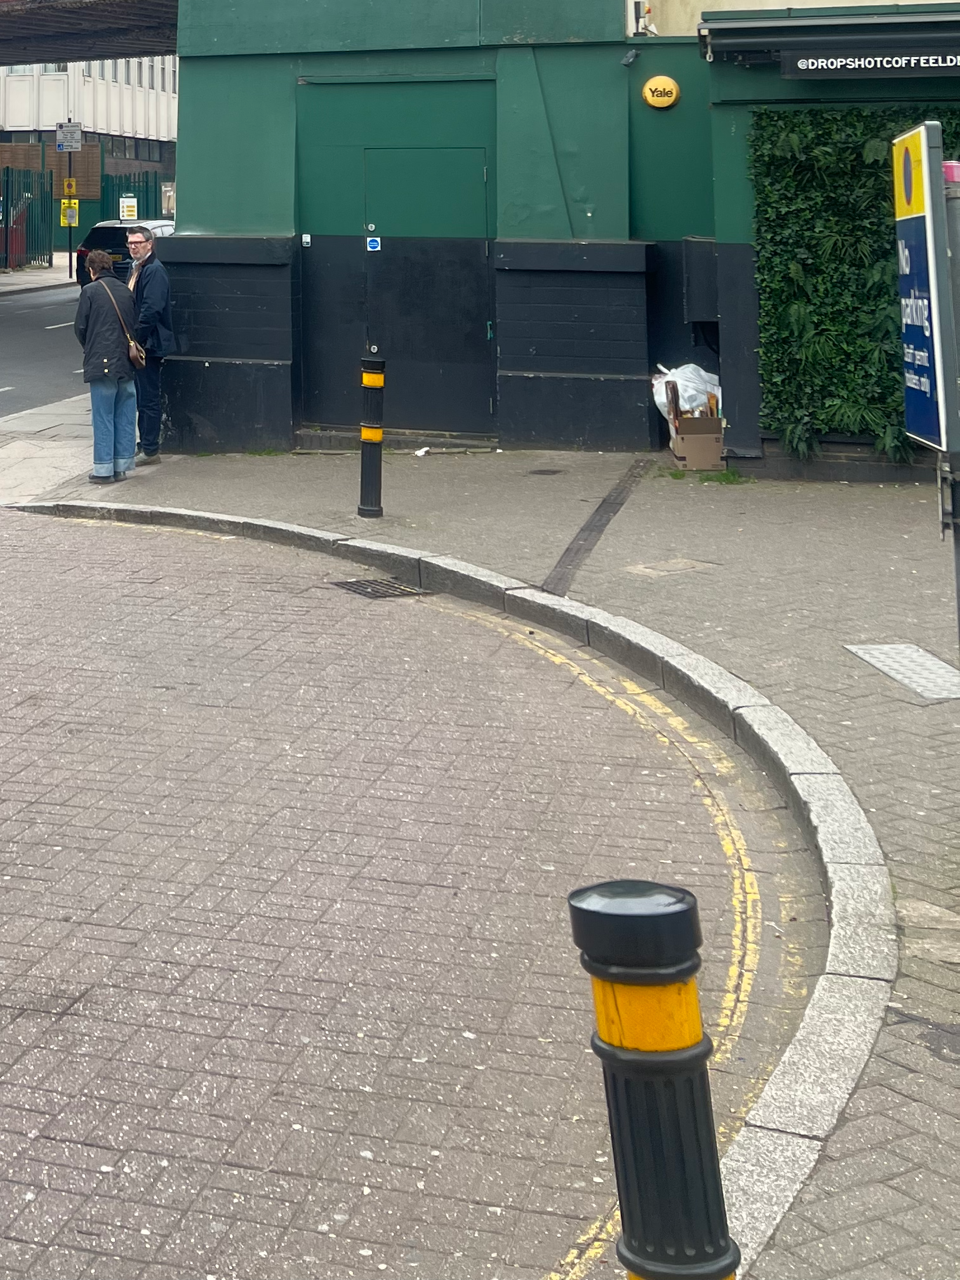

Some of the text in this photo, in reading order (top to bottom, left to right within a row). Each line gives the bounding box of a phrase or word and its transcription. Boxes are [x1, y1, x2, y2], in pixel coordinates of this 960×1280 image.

[649, 88, 673, 97] Yale
[897, 240, 910, 275] No
[901, 289, 930, 337] parking
